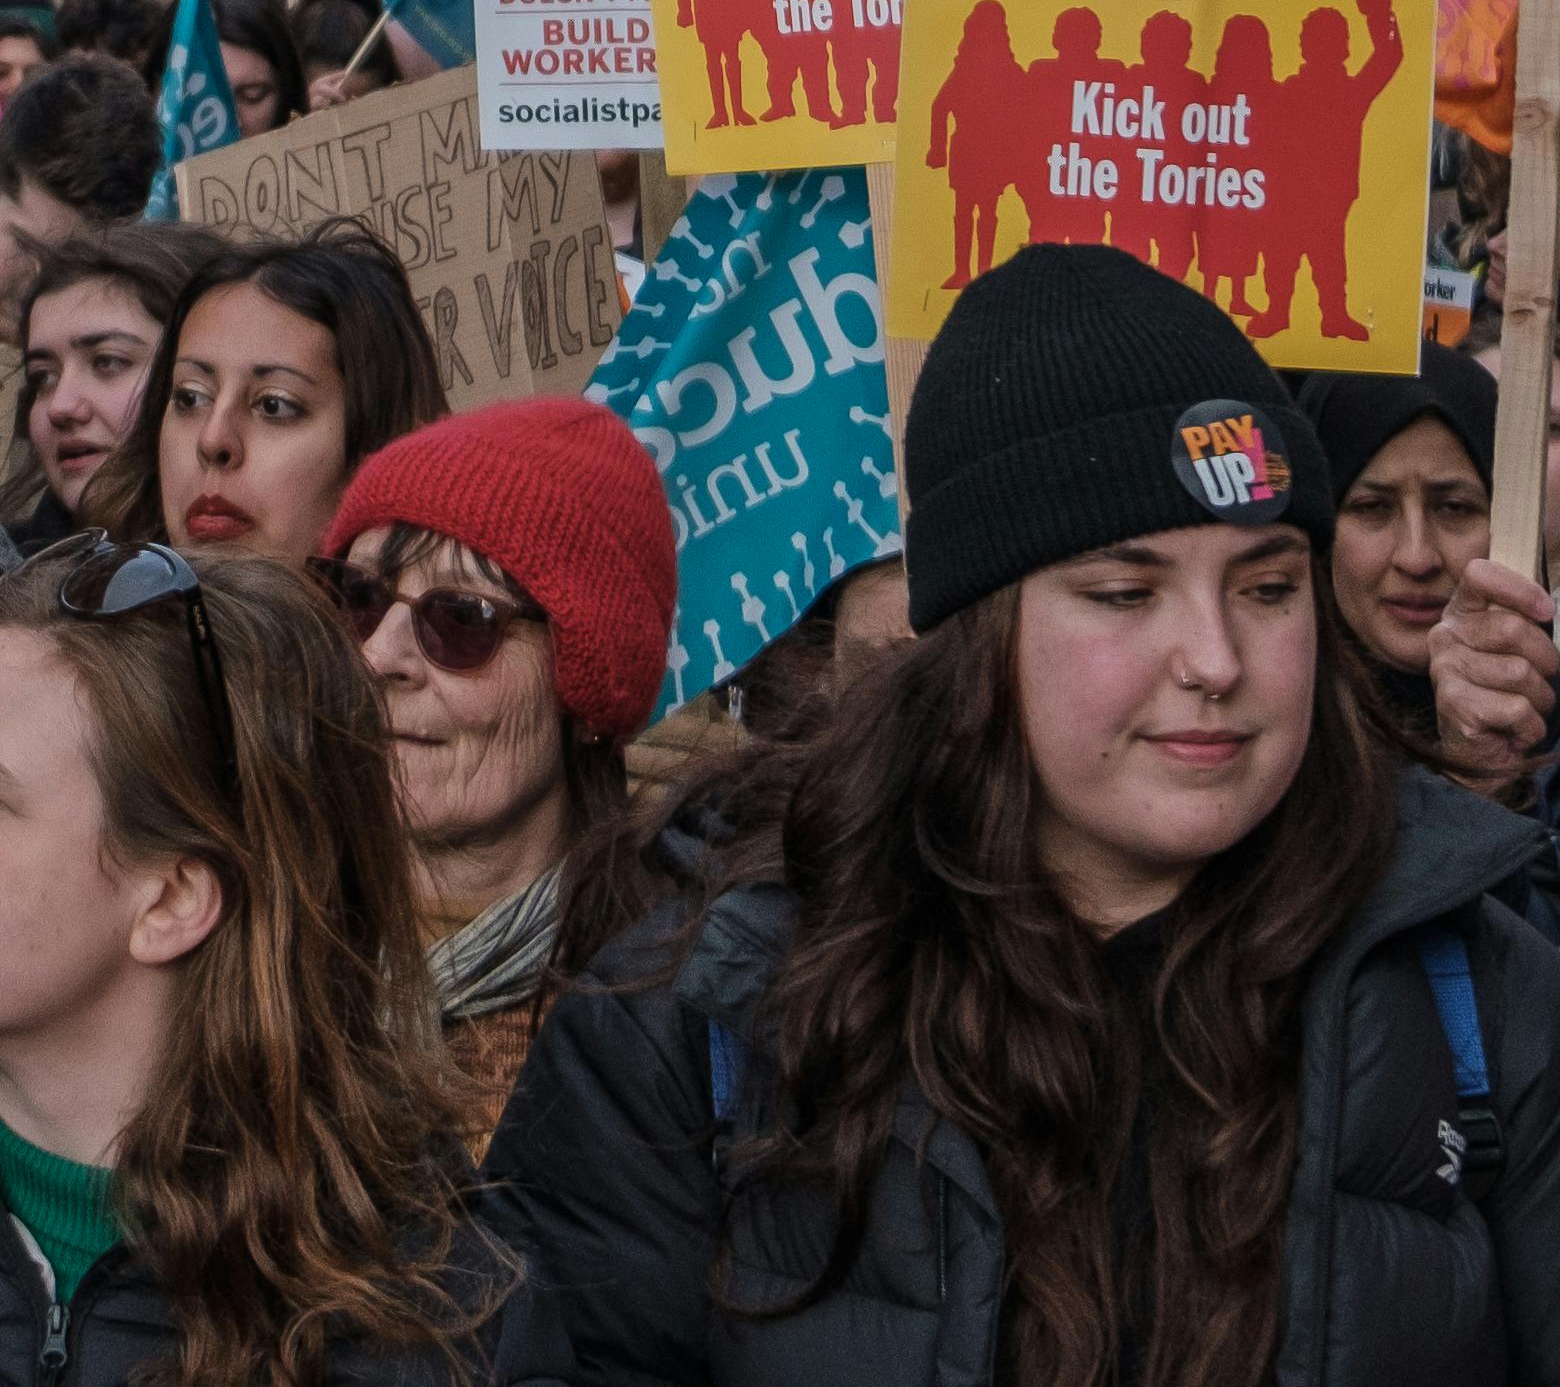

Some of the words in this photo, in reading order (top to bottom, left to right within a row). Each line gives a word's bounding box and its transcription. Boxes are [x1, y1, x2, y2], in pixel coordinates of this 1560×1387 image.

[502, 48, 657, 76] WORKER
[543, 18, 650, 47] BUILD
[1071, 79, 1166, 144] Kick
[1181, 93, 1252, 148] out
[486, 149, 572, 252] MY
[1046, 143, 1120, 203] the
[1137, 147, 1268, 210] Tories
[474, 225, 616, 379] VOICE
[1181, 414, 1255, 461] PAY
